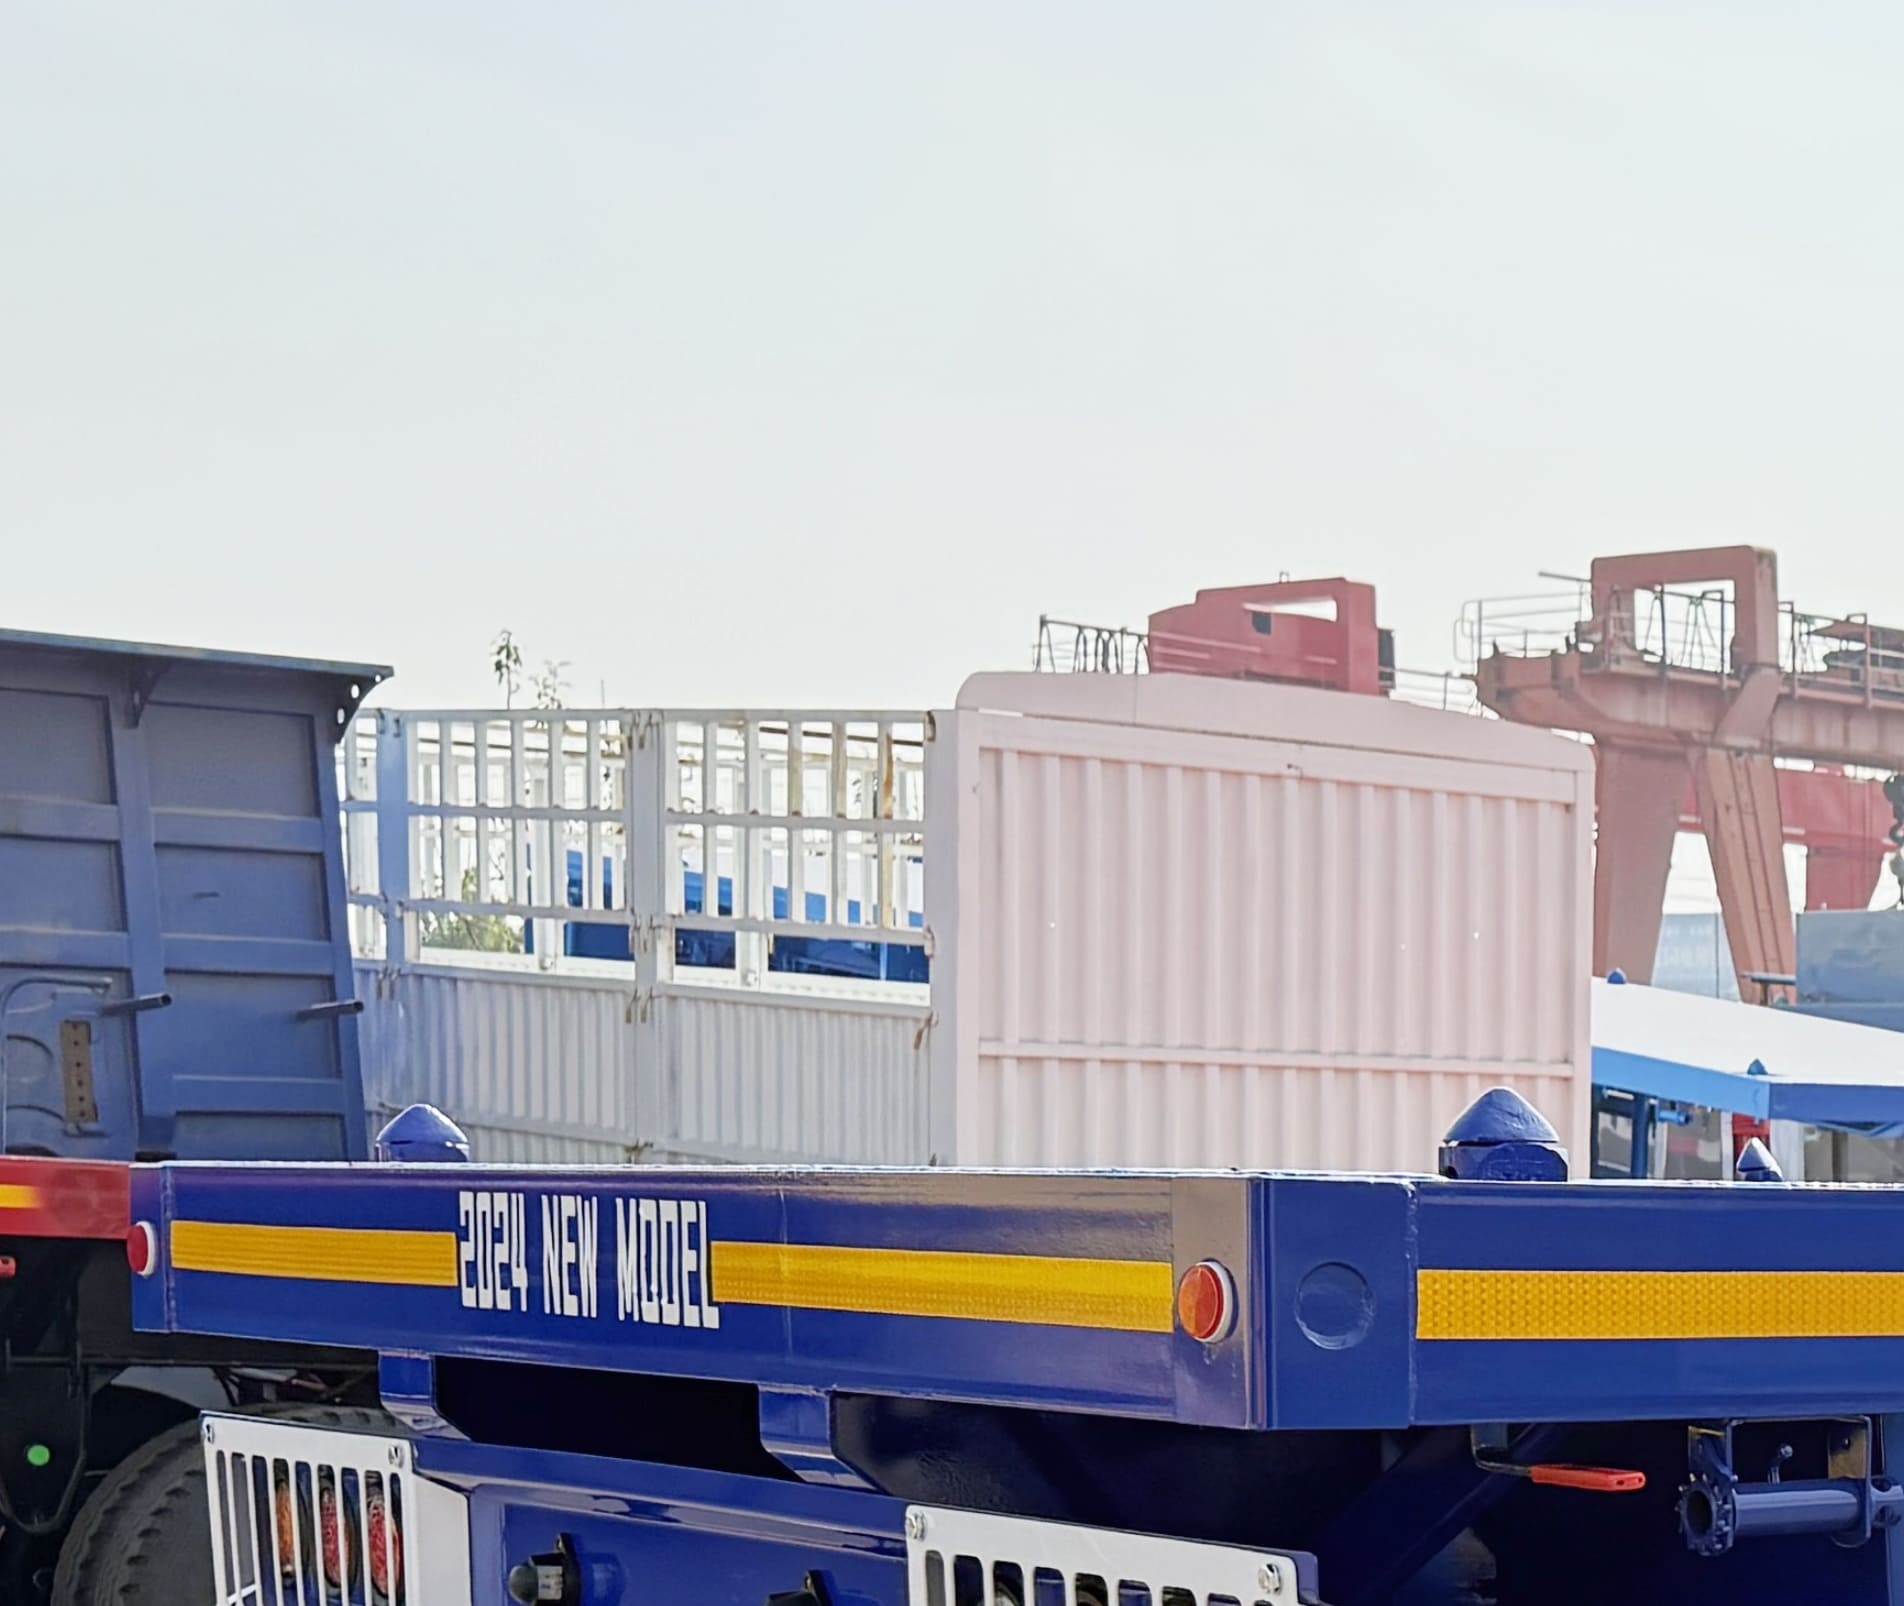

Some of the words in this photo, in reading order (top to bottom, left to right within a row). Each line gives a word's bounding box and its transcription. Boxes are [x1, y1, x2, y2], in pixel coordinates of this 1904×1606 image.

[458, 1191, 529, 1313] 2024
[540, 1194, 600, 1319] NEW
[615, 1197, 721, 1330] MODEL
